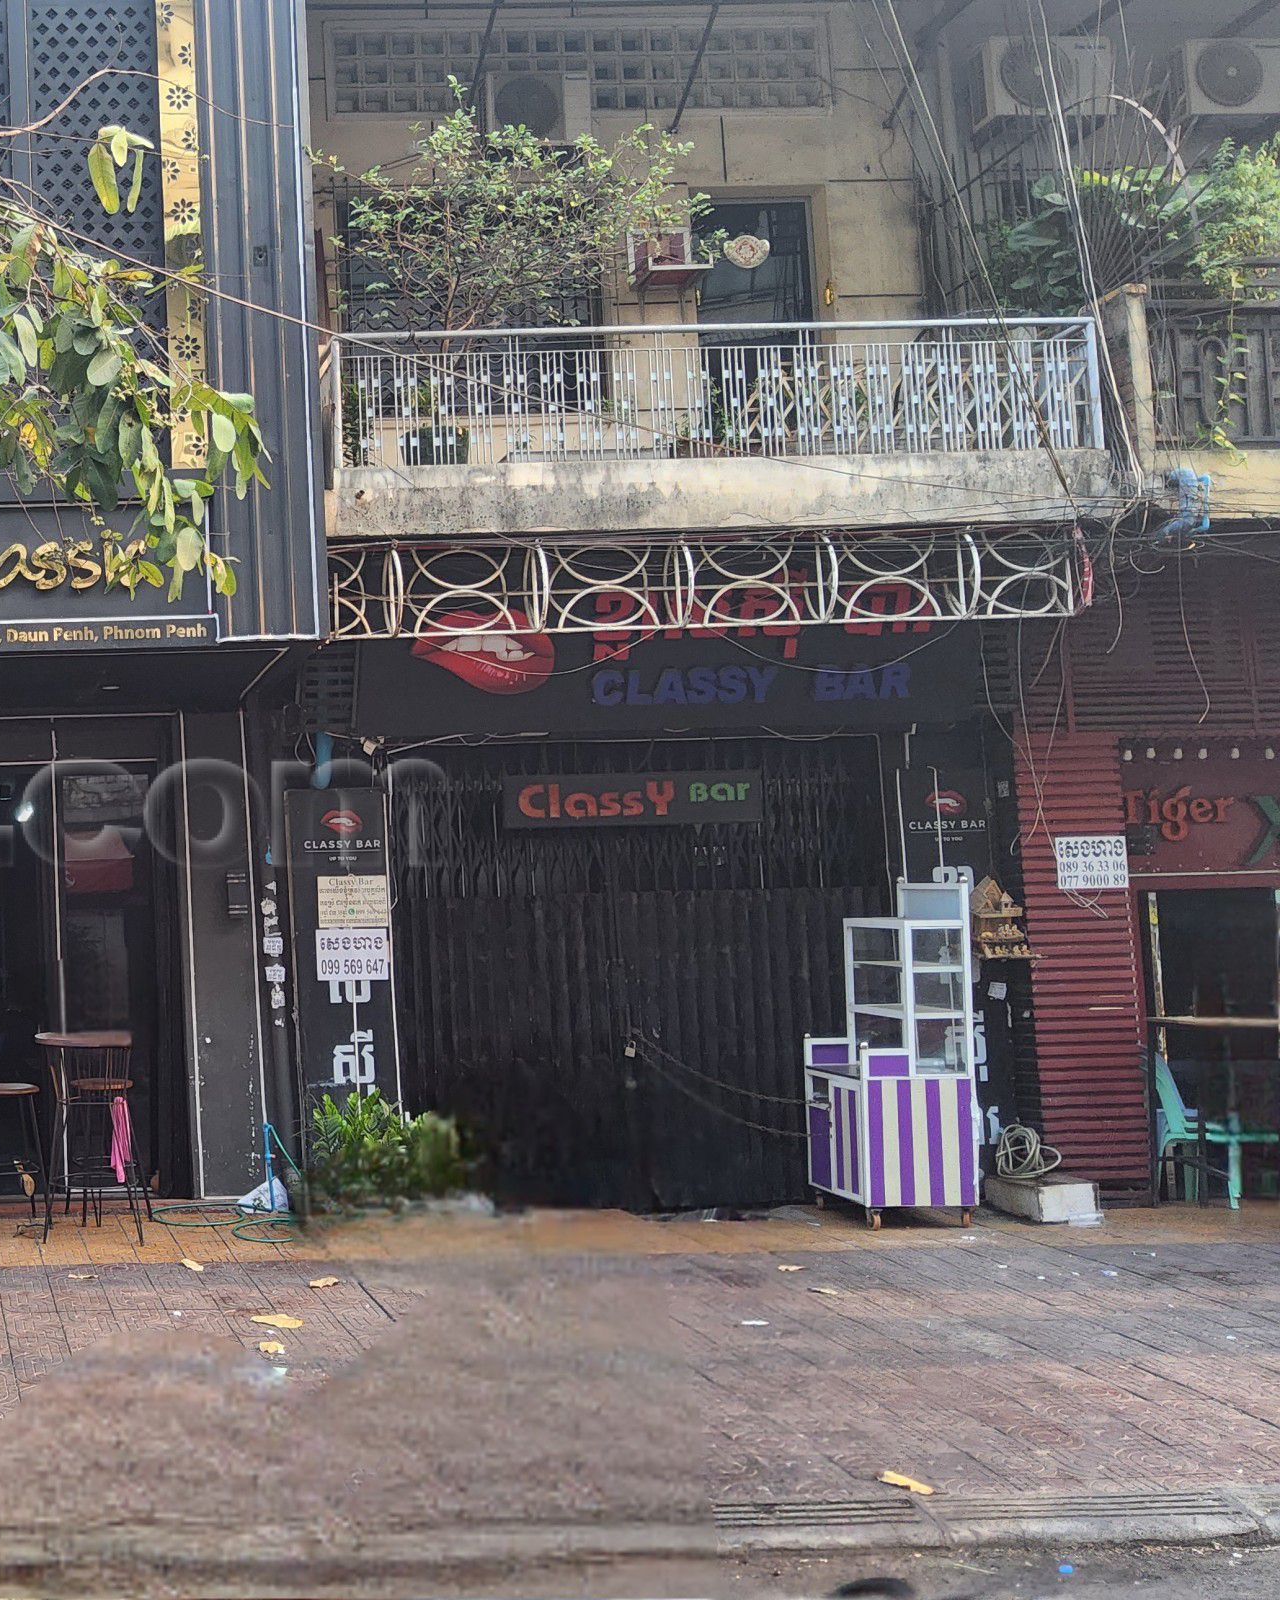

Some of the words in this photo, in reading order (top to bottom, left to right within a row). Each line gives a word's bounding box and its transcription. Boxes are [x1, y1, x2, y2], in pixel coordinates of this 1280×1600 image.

[6, 628, 49, 643] Daun
[103, 625, 161, 641] Phnom
[167, 623, 207, 639] Penh
[591, 664, 778, 706] CLASSY
[814, 662, 912, 702] BAR
[1125, 785, 1235, 842] Tiger
[909, 821, 956, 830] CLASSY
[961, 820, 986, 829] BAR
[304, 840, 351, 849] CLASSY
[356, 839, 381, 849] BAR
[1060, 861, 1079, 873] 089
[1082, 861, 1095, 872] 36
[1098, 860, 1110, 872] 33
[1112, 860, 1126, 871] 06
[328, 877, 356, 887] Classy
[358, 877, 374, 885] Bar
[1060, 875, 1079, 887] 077
[1082, 874, 1110, 886] 9000
[1113, 873, 1126, 885] 89
[320, 936, 384, 950] សេងហាង
[321, 959, 340, 975] 099
[344, 959, 363, 975] 569
[366, 958, 384, 975] 647
